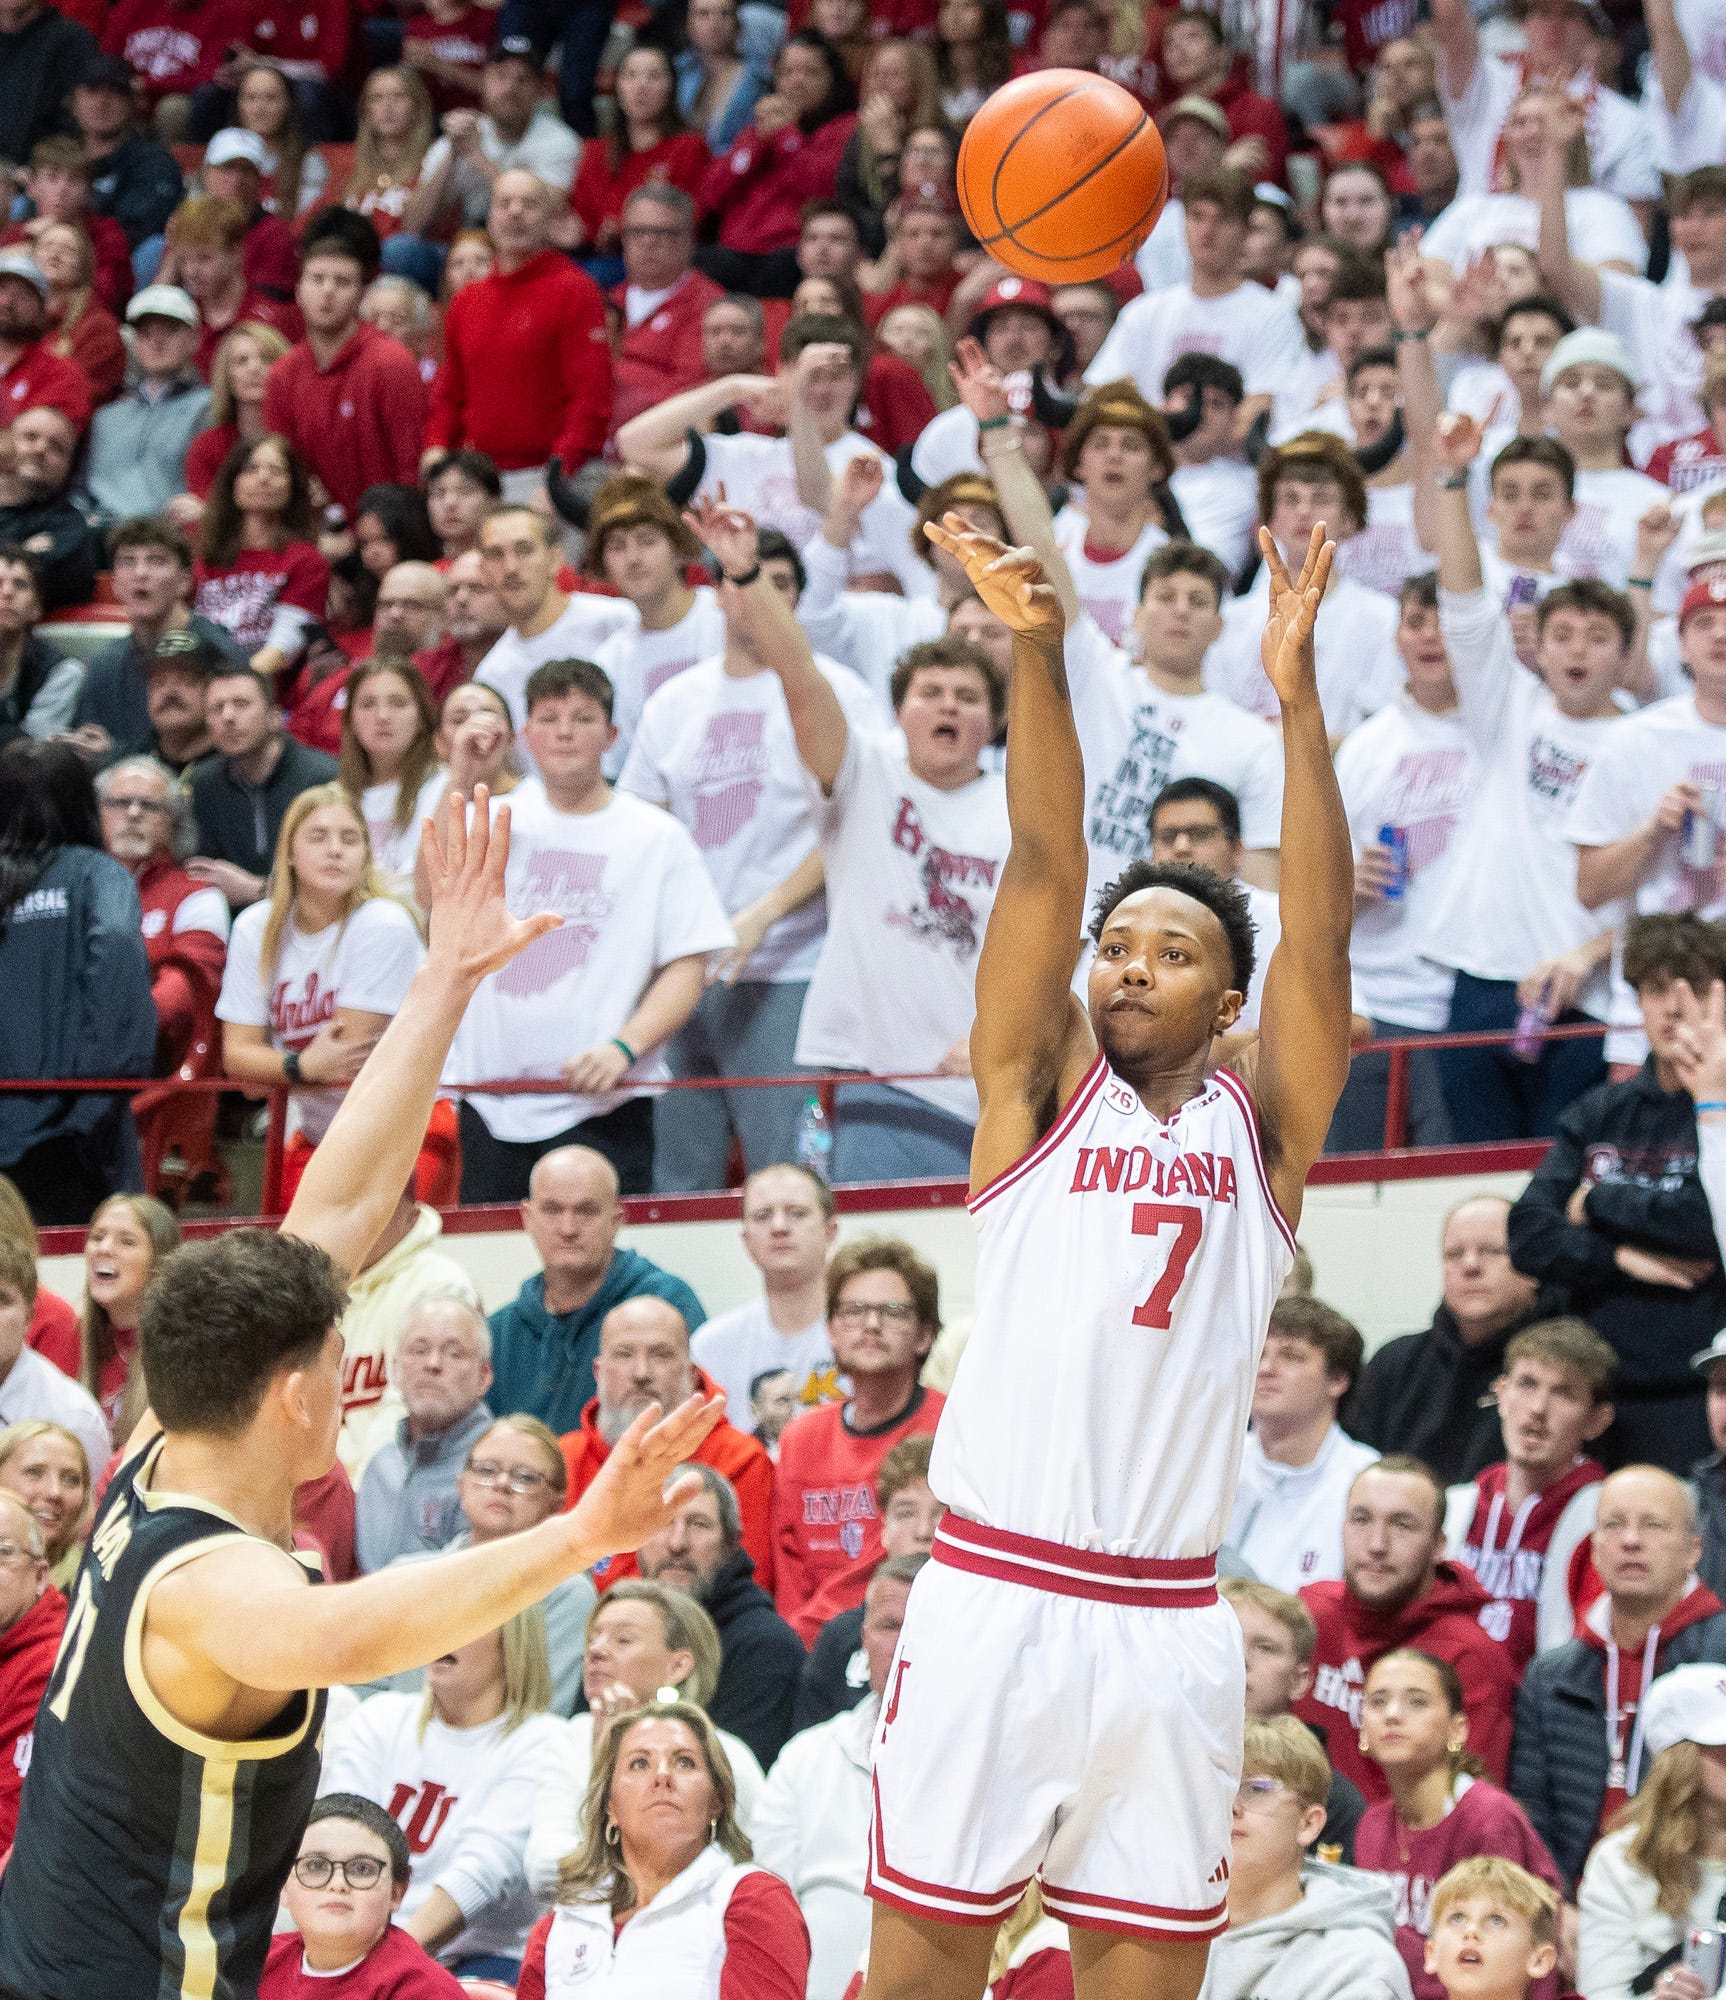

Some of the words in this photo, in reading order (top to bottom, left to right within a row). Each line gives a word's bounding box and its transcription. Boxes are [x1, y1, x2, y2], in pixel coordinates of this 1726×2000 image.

[1110, 1083, 1133, 1109] 76
[1069, 1145, 1238, 1211] INDIANA
[1131, 1202, 1203, 1330] 7
